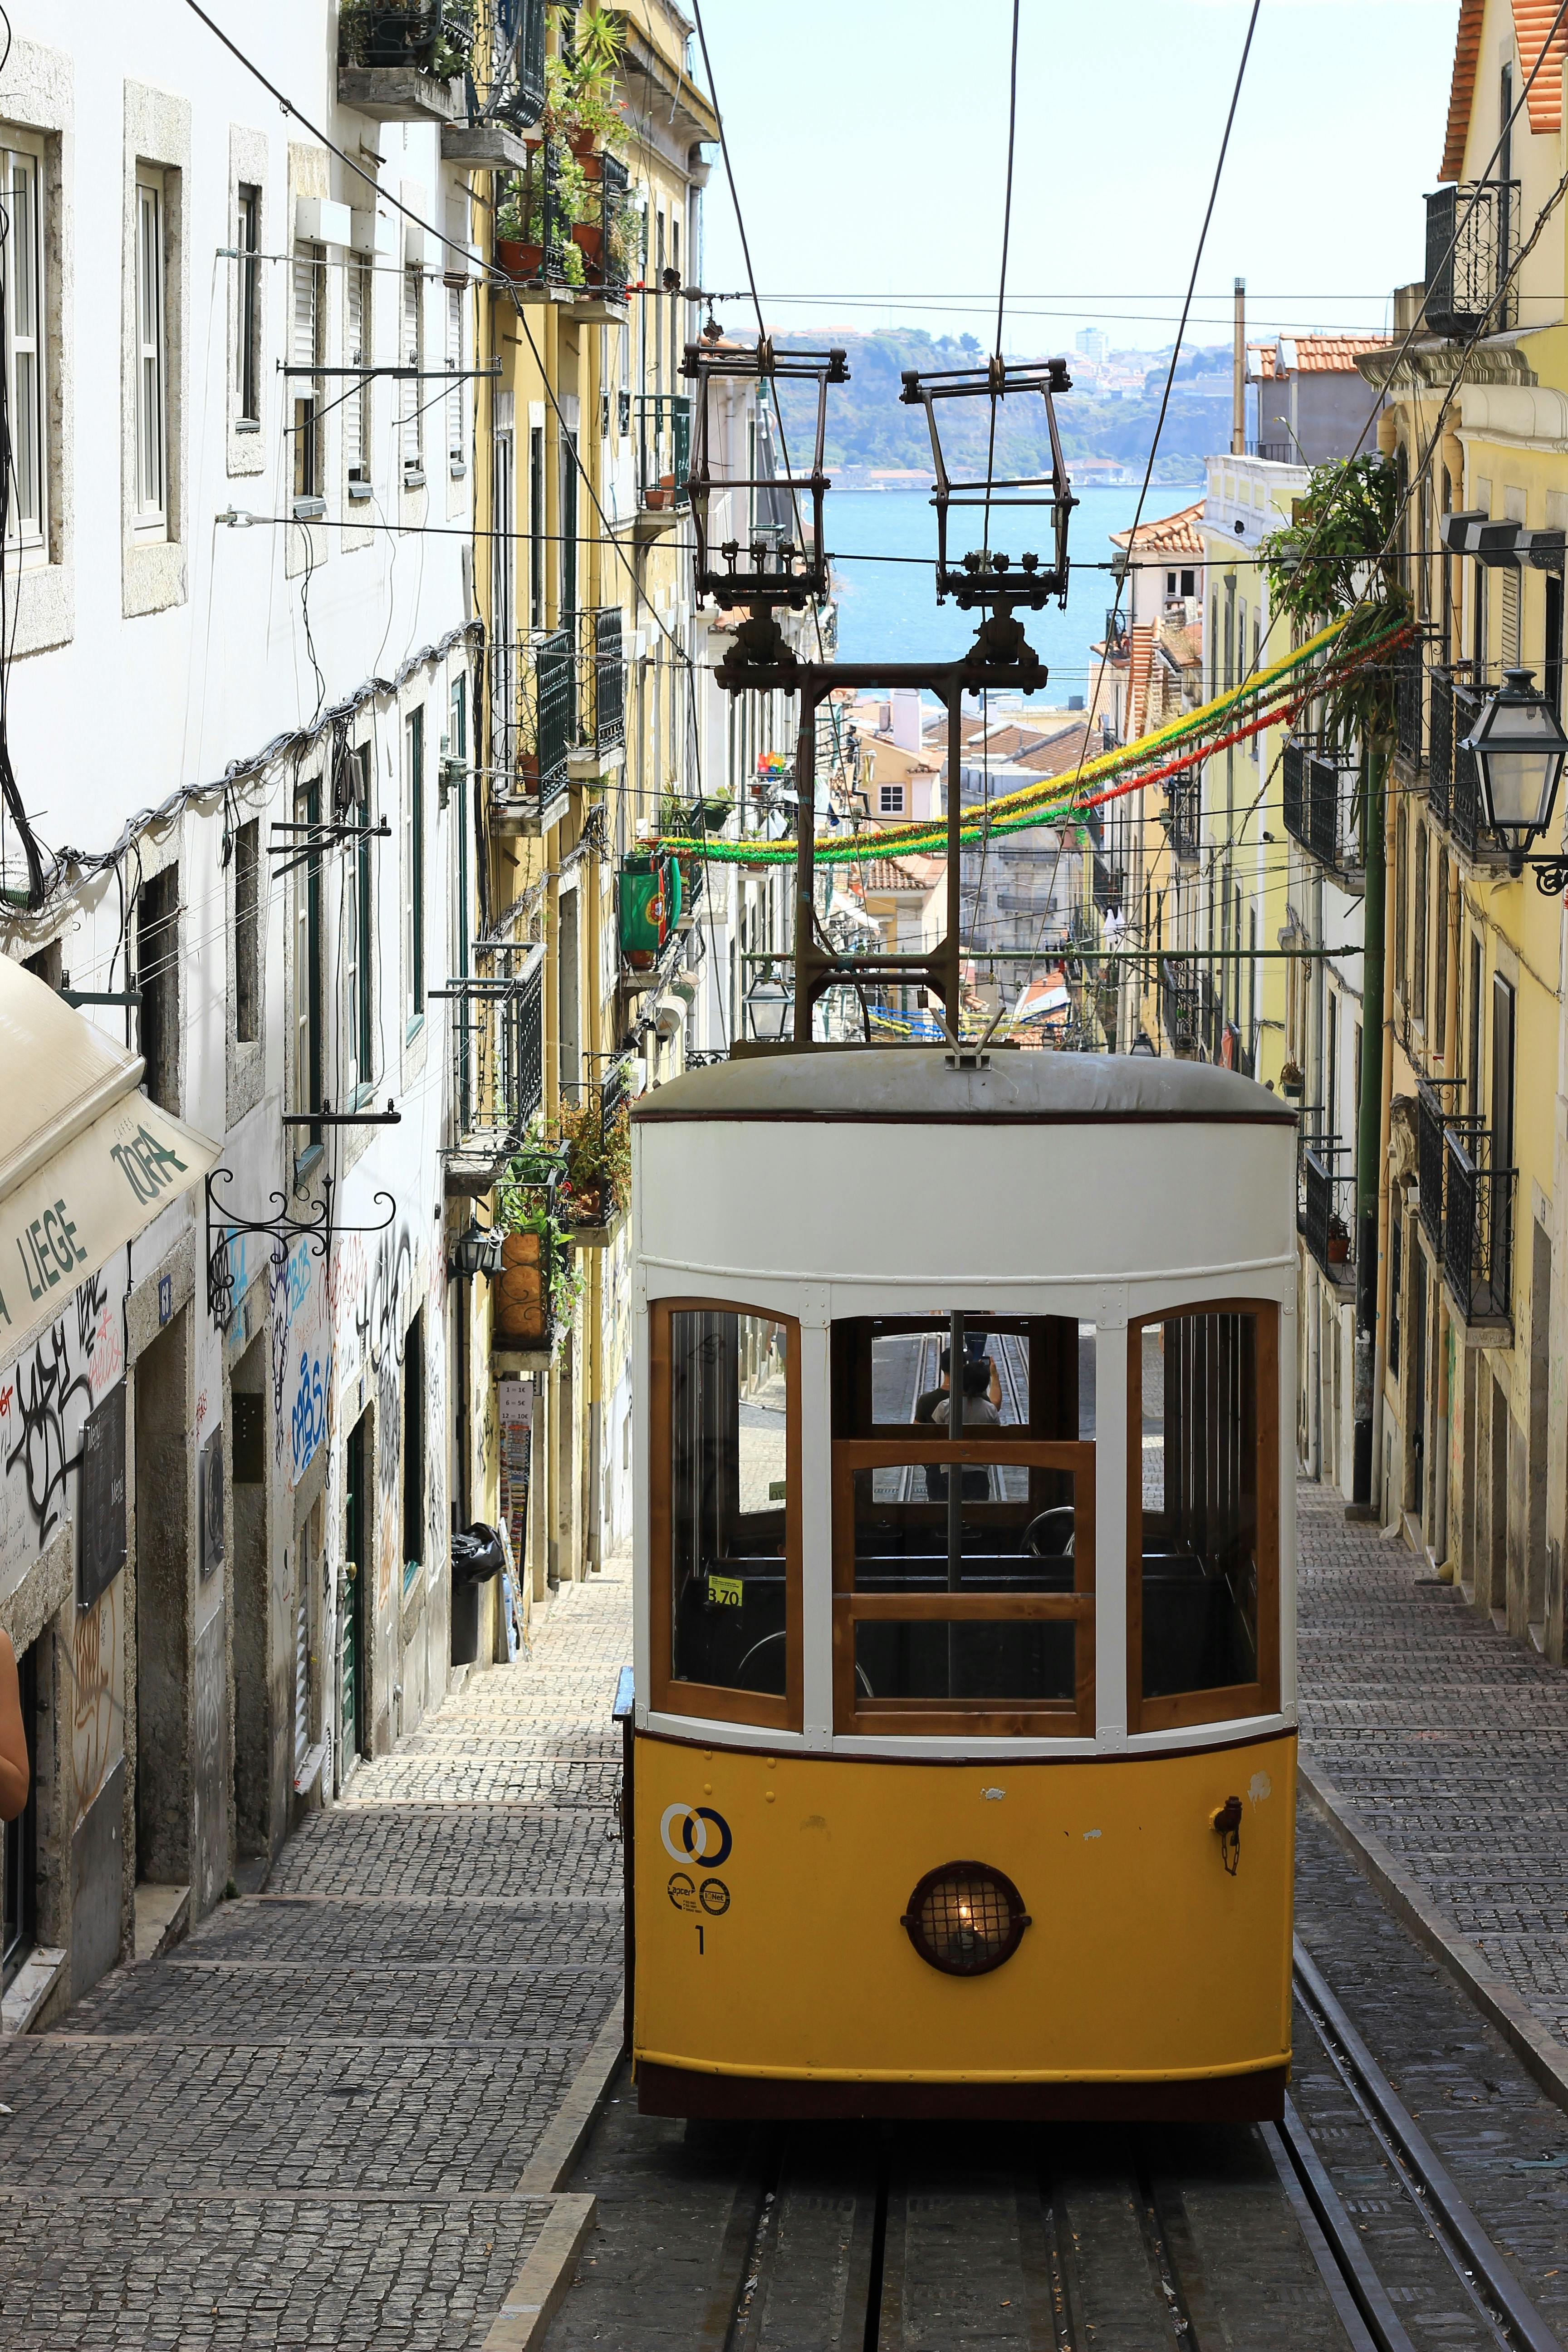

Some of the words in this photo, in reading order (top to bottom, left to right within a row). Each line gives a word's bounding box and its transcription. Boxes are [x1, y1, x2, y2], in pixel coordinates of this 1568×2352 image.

[113, 1117, 134, 1140] CAFÉS
[110, 1124, 189, 1205] TOFA
[16, 1199, 88, 1302] LIEGE
[162, 1282, 169, 1316] 68
[87, 1414, 100, 1451] Menú
[111, 1469, 123, 1506] Menú
[709, 1588, 739, 1605] 3.70
[672, 1887, 691, 1896] apcer
[705, 1892, 724, 1901] IQNet
[695, 1925, 704, 1955] 1
